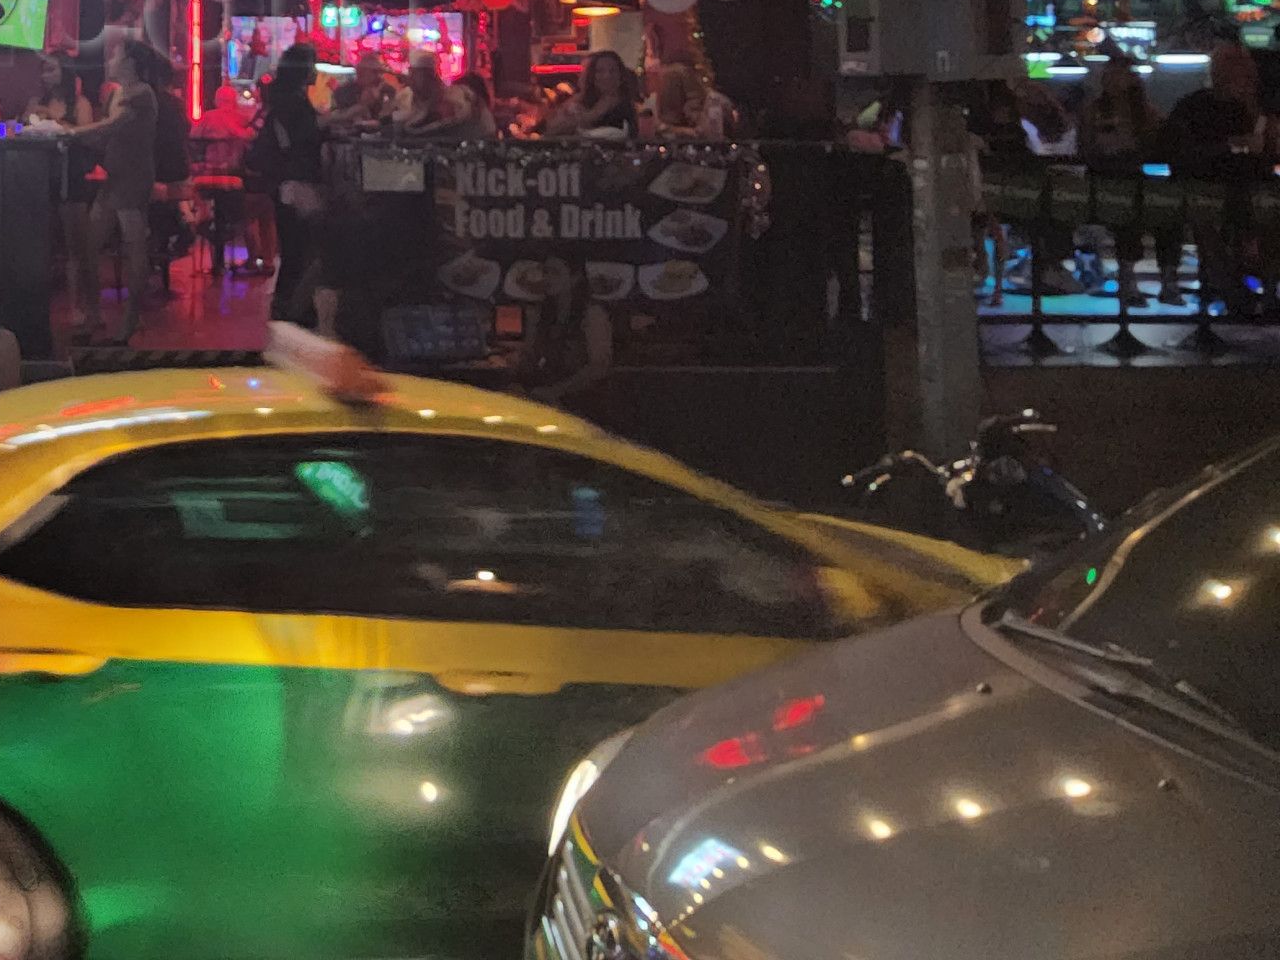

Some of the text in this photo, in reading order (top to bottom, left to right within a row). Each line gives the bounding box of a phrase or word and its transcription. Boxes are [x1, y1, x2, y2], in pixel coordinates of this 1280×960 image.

[454, 161, 581, 197] Kick-off
[453, 201, 643, 240] Food & Drink
